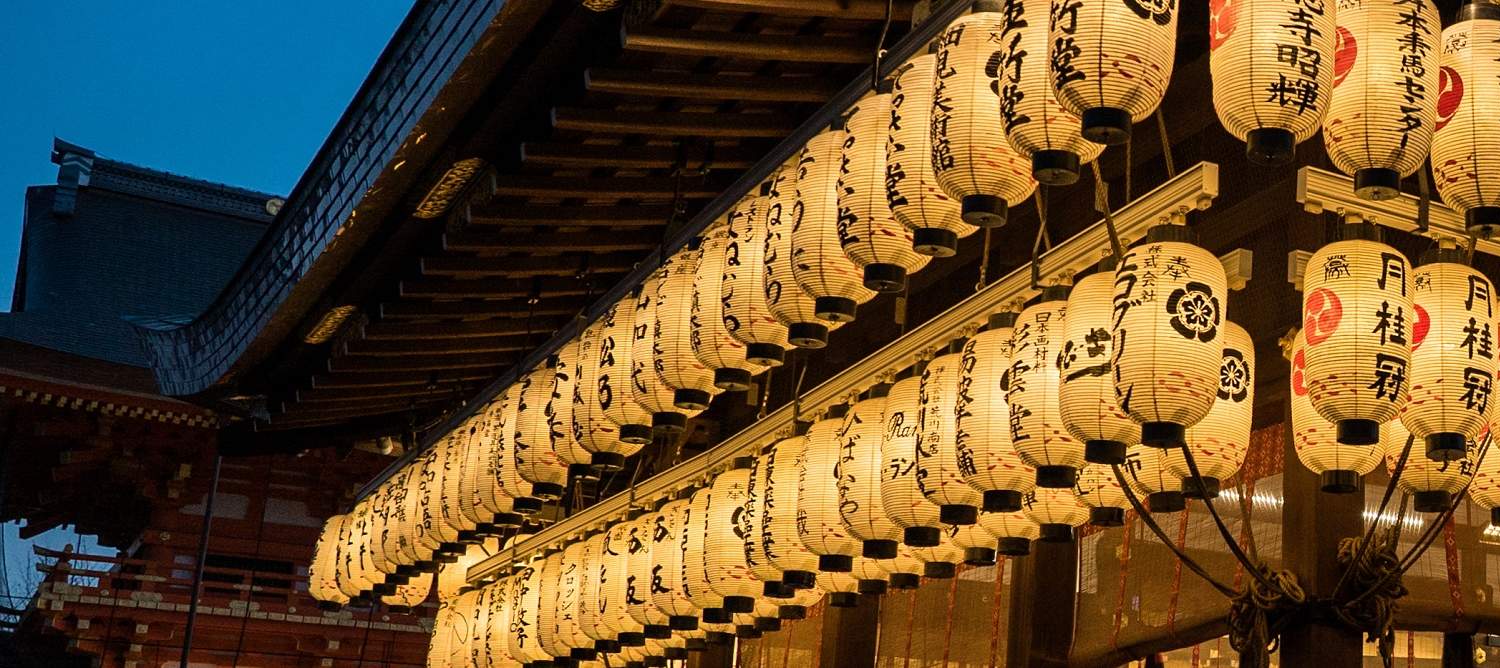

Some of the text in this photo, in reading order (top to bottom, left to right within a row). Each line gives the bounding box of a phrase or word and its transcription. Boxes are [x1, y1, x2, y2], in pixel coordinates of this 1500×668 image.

[1142, 245, 1162, 303] 株式会社
[1368, 252, 1408, 402] 月桂冠
[1459, 275, 1493, 415] 月桂冠
[890, 458, 916, 480] ラン
[562, 563, 577, 621] クロッシェ
